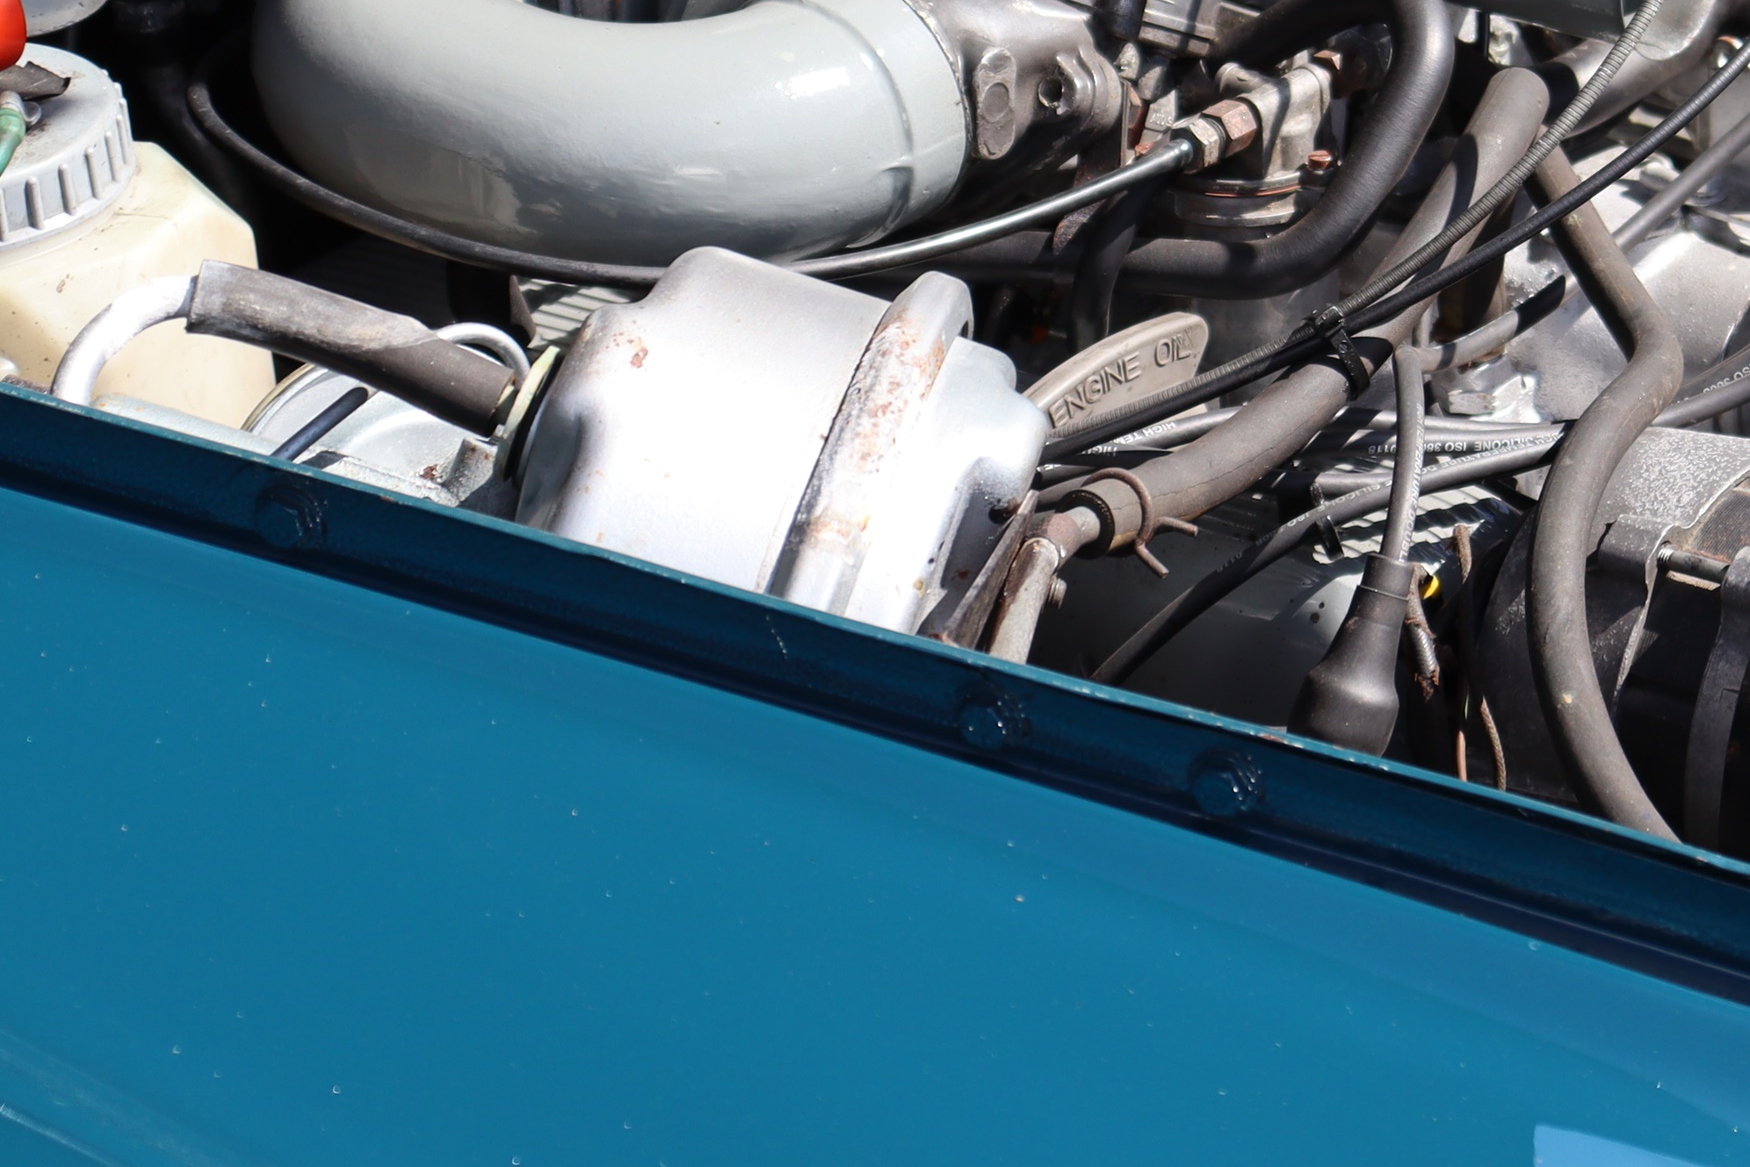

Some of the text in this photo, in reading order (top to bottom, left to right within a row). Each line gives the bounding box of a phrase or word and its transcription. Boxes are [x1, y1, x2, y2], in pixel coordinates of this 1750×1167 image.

[1048, 351, 1142, 428] ENGINE
[1144, 421, 1176, 438] HIGH
[1444, 441, 1468, 453] ISO
[1398, 510, 1417, 562] DOUBL
